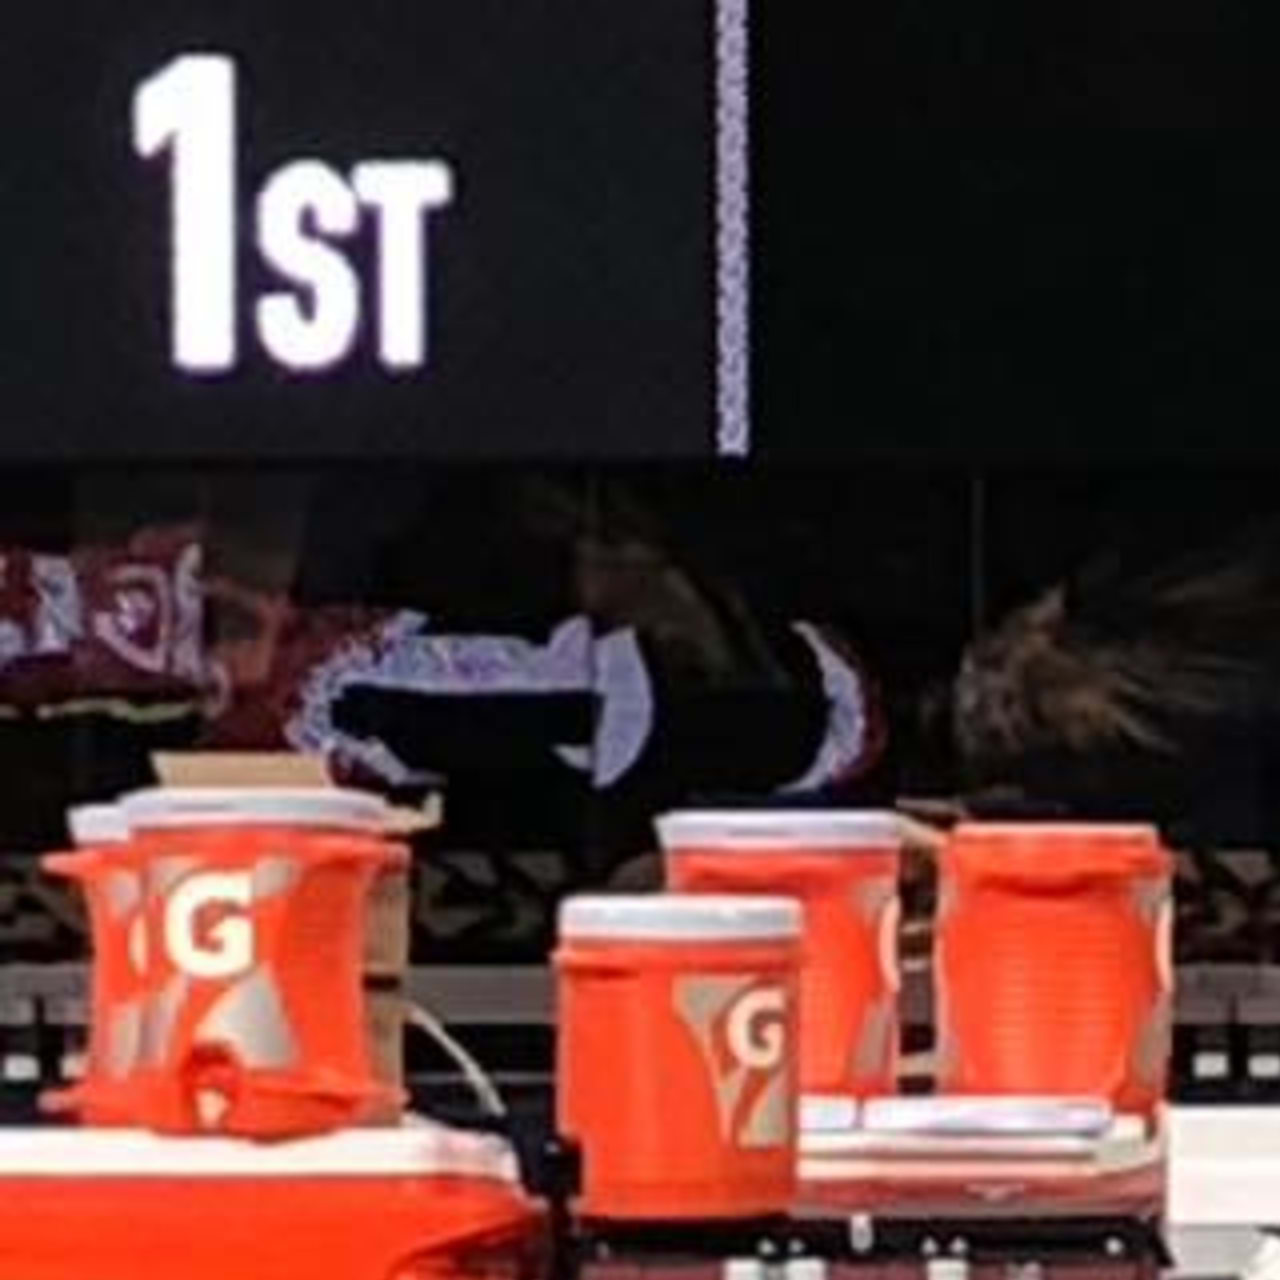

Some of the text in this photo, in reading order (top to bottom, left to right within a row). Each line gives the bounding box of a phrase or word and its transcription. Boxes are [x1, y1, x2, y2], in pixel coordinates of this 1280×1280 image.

[132, 52, 453, 372] 1ST
[163, 871, 254, 977] G
[727, 985, 786, 1068] G
